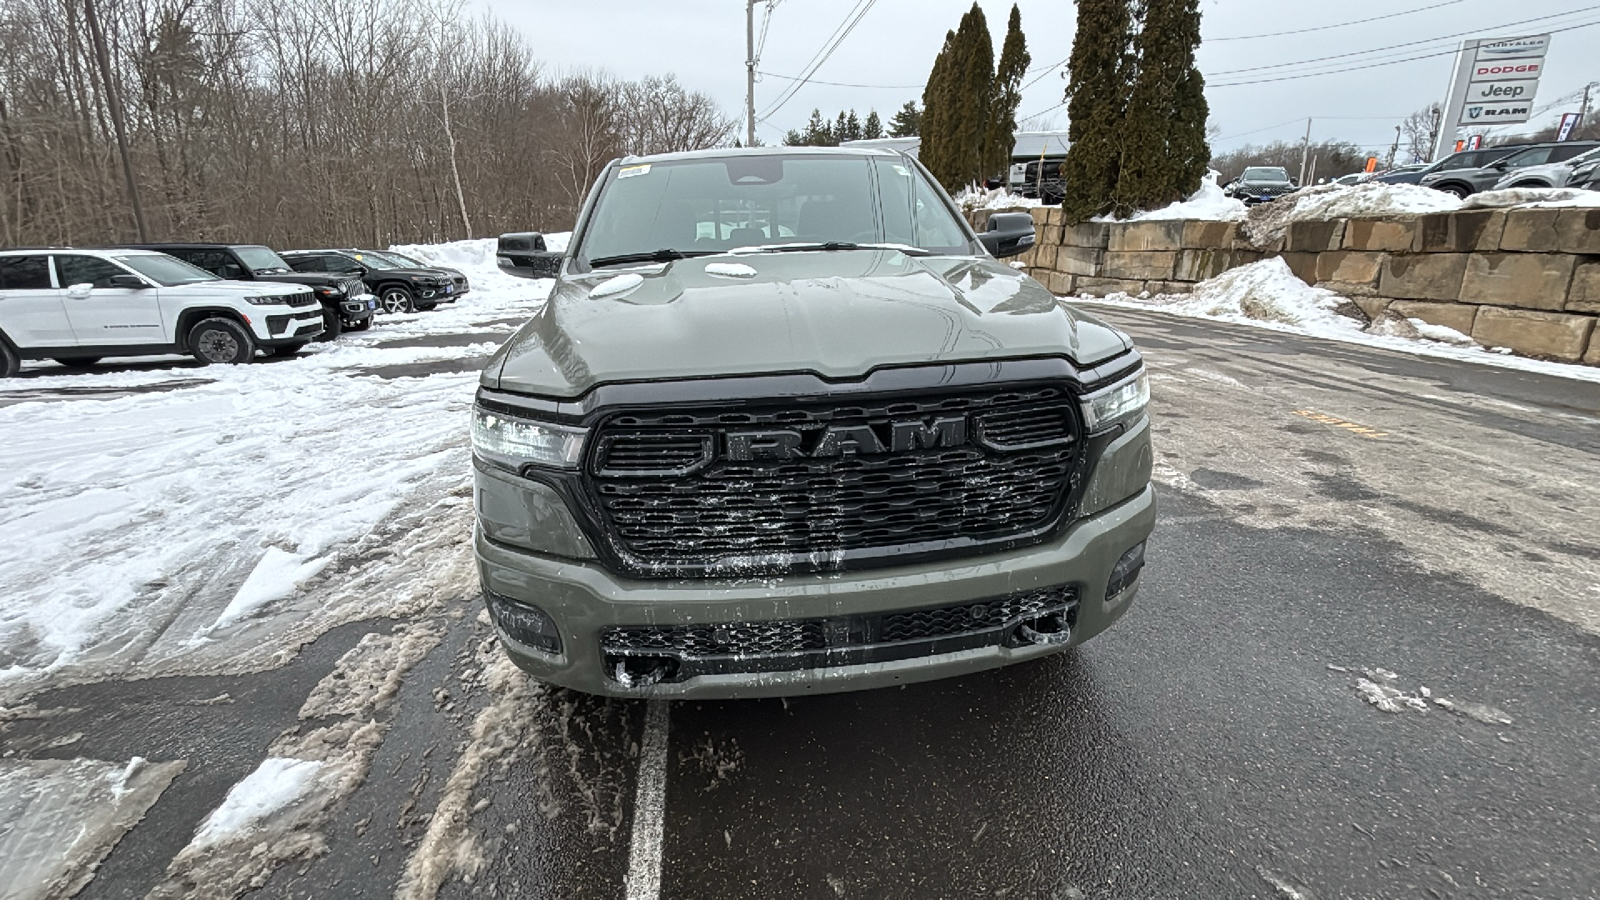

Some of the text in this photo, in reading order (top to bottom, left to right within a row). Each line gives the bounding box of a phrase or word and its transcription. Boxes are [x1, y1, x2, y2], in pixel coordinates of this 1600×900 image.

[1477, 64, 1539, 75] DODGE
[1481, 84, 1524, 98] Jeep
[1484, 108, 1527, 116] RAM
[726, 416, 966, 461] RAM
